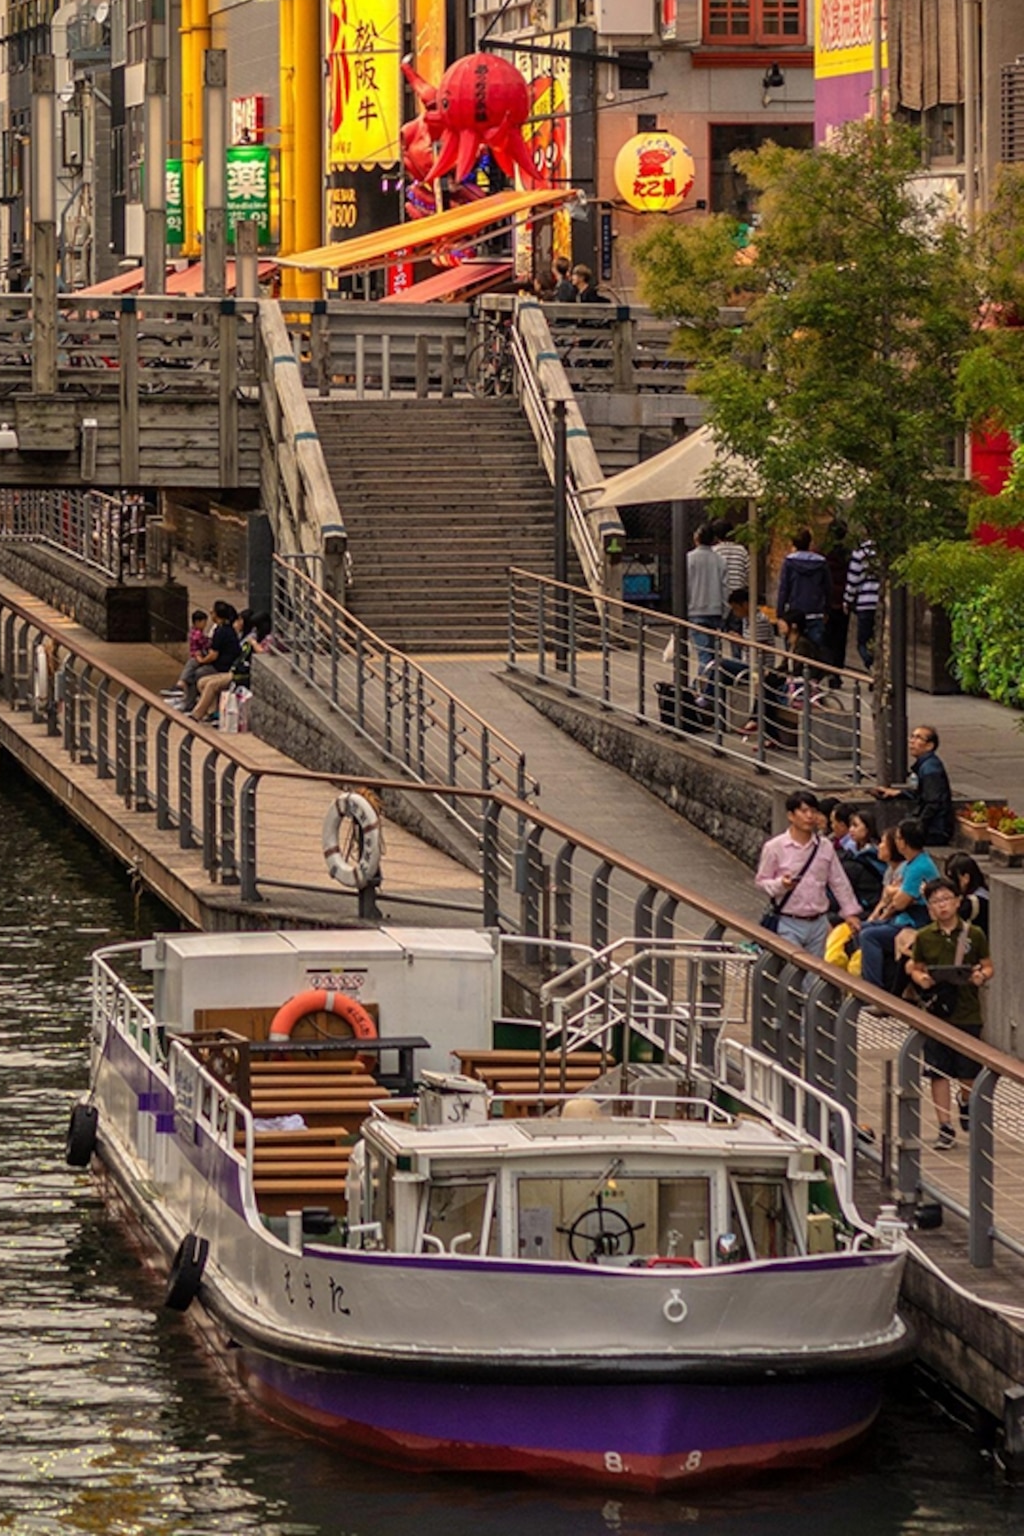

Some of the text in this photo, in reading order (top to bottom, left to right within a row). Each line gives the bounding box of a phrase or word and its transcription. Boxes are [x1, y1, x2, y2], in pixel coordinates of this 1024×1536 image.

[353, 19, 381, 131] 松阪牛
[226, 160, 268, 200] 薬
